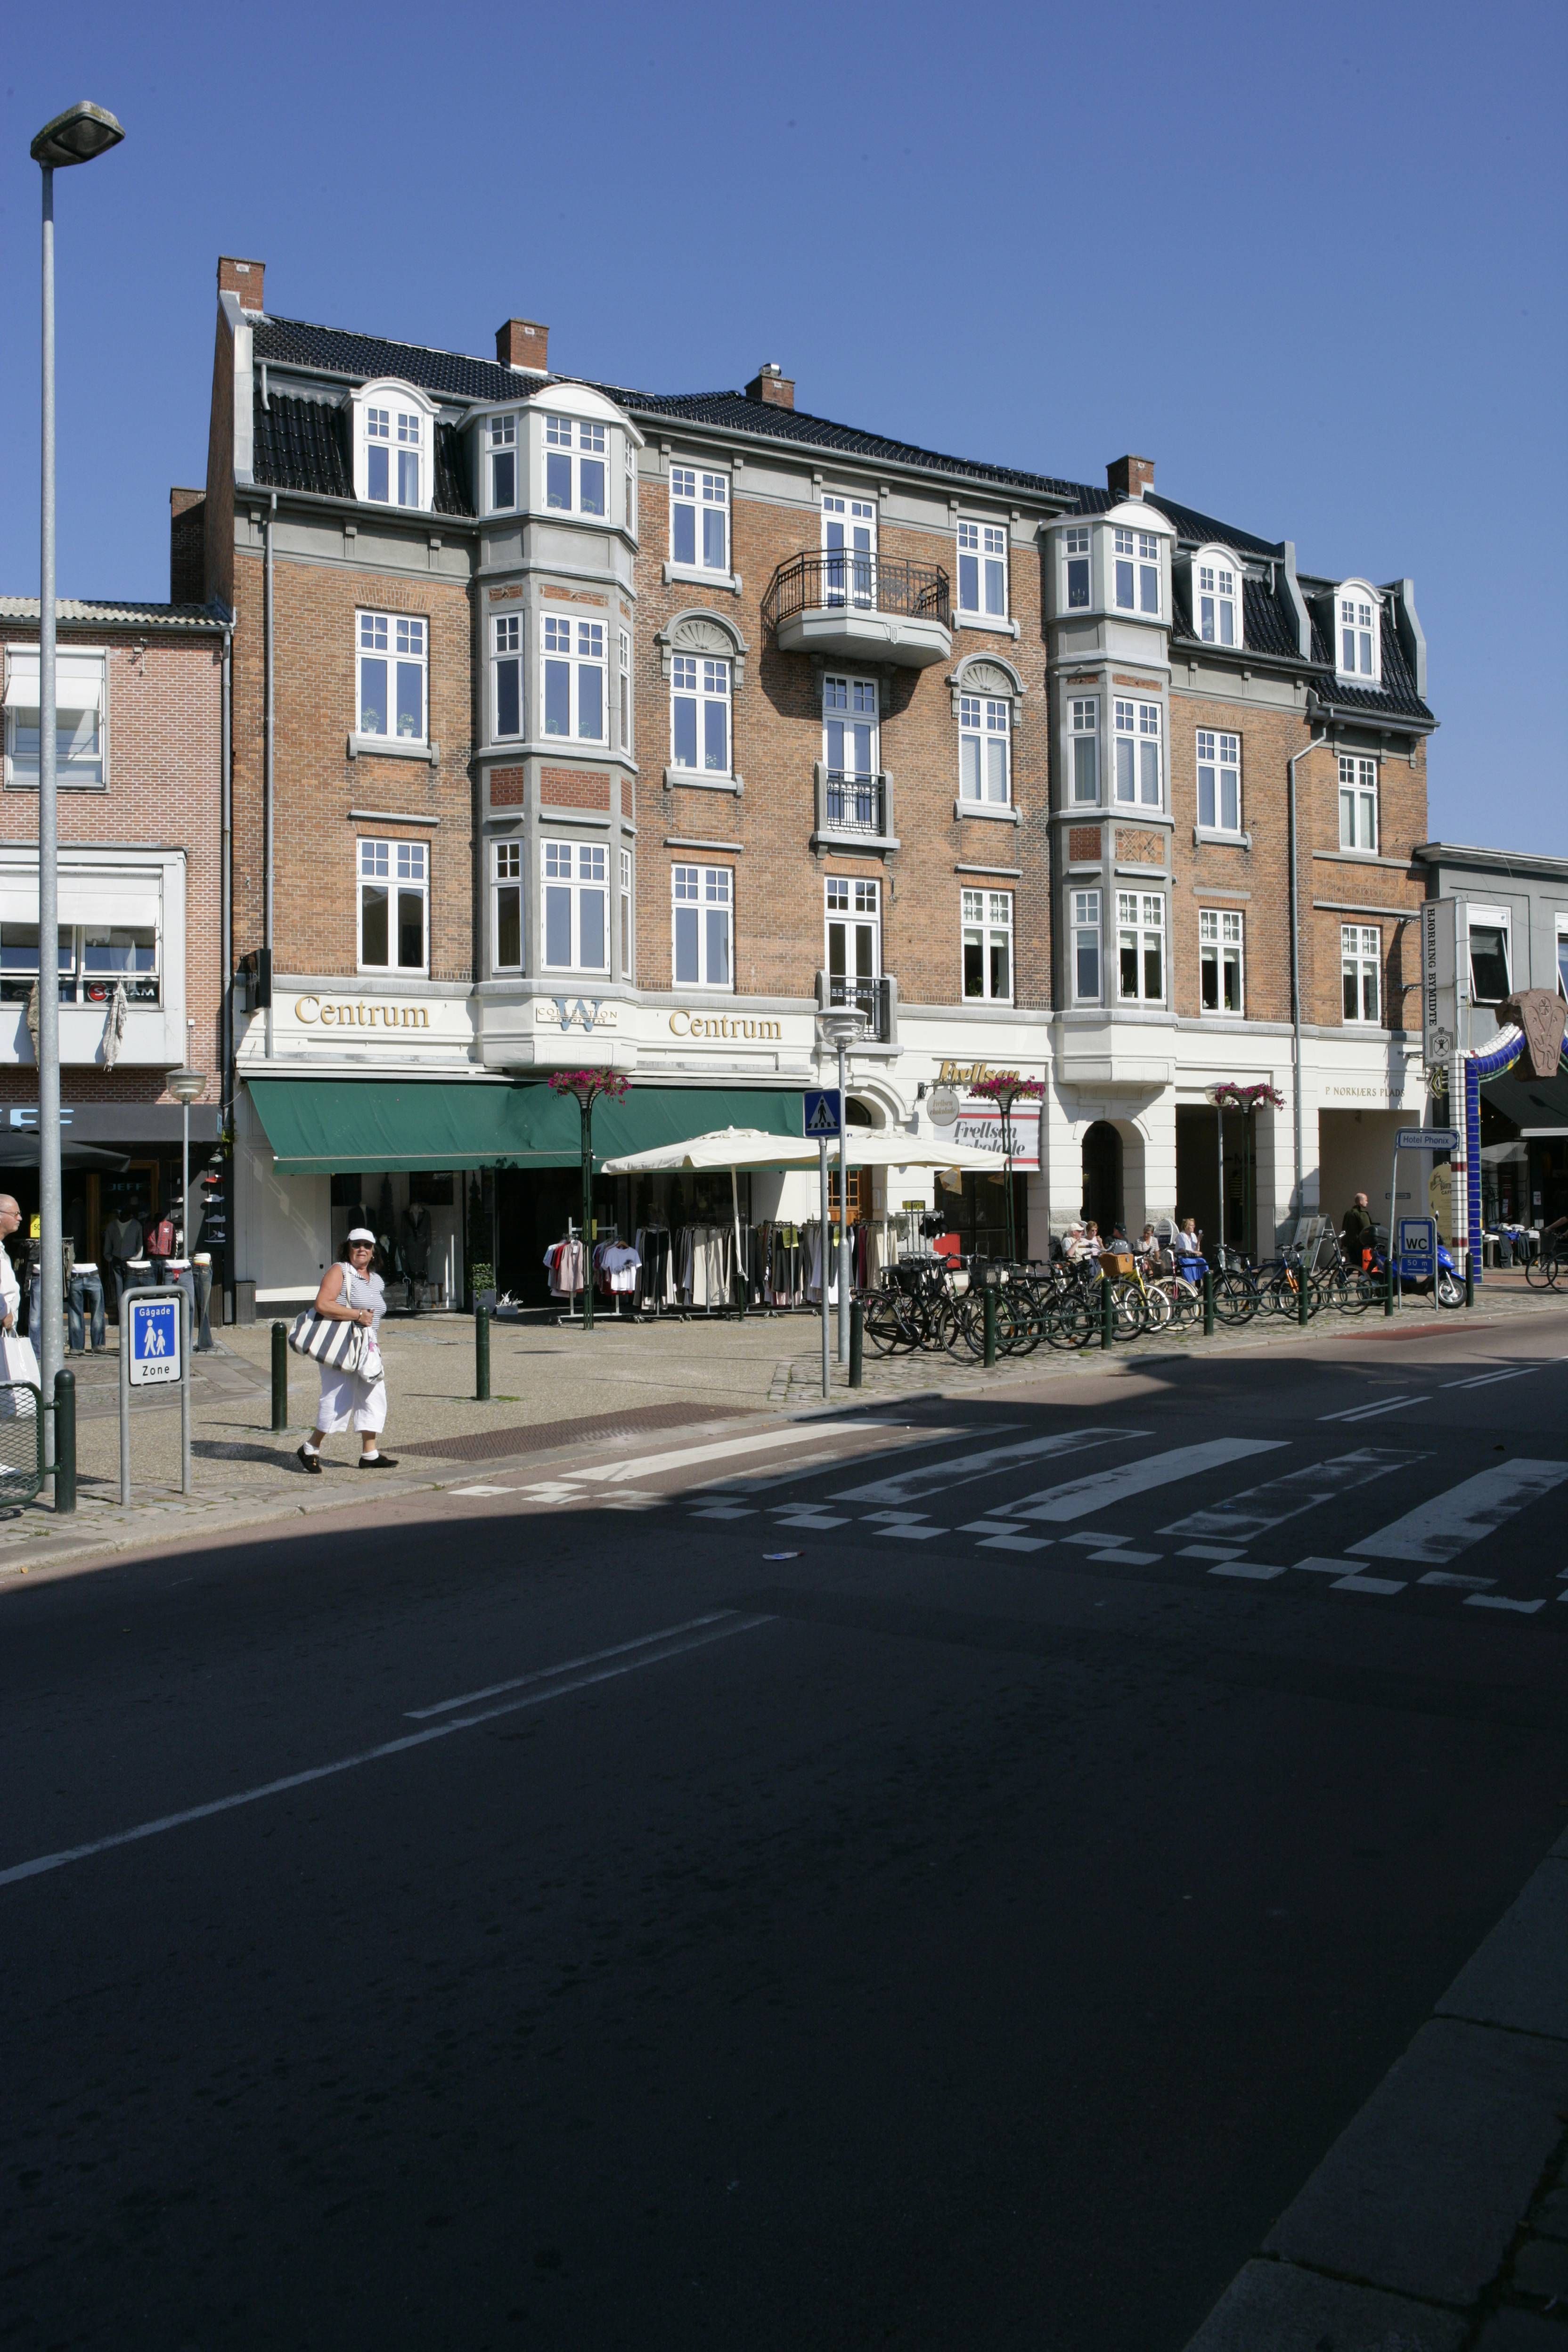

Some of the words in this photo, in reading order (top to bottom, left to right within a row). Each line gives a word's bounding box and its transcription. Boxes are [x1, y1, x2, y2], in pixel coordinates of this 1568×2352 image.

[1428, 908, 1436, 969] HJØRRING
[1428, 972, 1437, 1026] BYMIDTE
[294, 995, 430, 1027] Centrum
[538, 1007, 618, 1019] COLLECTION
[669, 1010, 782, 1039] Centrum
[1333, 1087, 1377, 1097] NØRKJÆRS
[1380, 1088, 1405, 1097] PLADS
[953, 1121, 1017, 1139] Frellsen
[1403, 1135, 1422, 1143] Hotel
[1406, 1238, 1428, 1250] WC
[139, 1307, 171, 1317] Gågade
[142, 1365, 170, 1376] Zone
